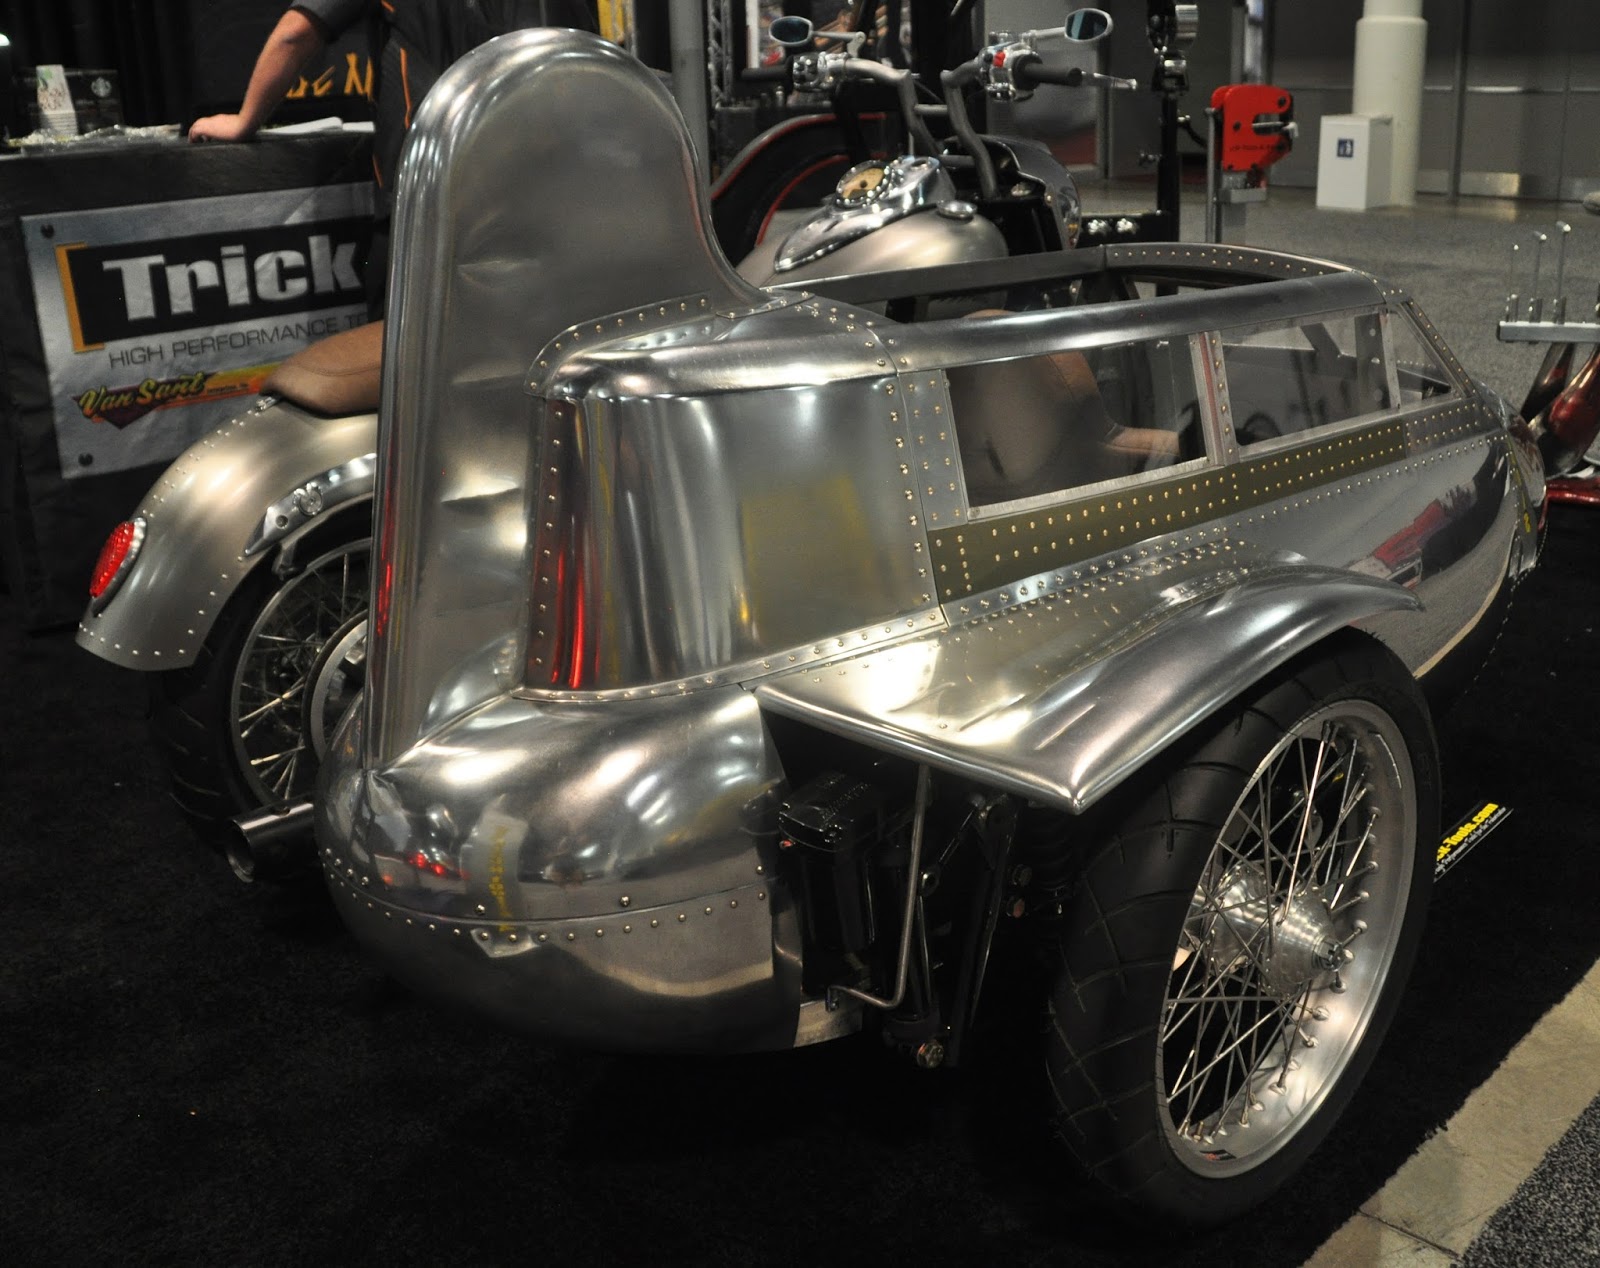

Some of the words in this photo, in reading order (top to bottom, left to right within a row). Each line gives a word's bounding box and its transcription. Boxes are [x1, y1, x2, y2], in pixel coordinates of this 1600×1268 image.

[102, 234, 361, 320] Trick
[109, 345, 164, 368] HIGH
[172, 316, 337, 358] PERFORMANCE
[79, 385, 135, 416] Van
[136, 371, 205, 405] Sant
